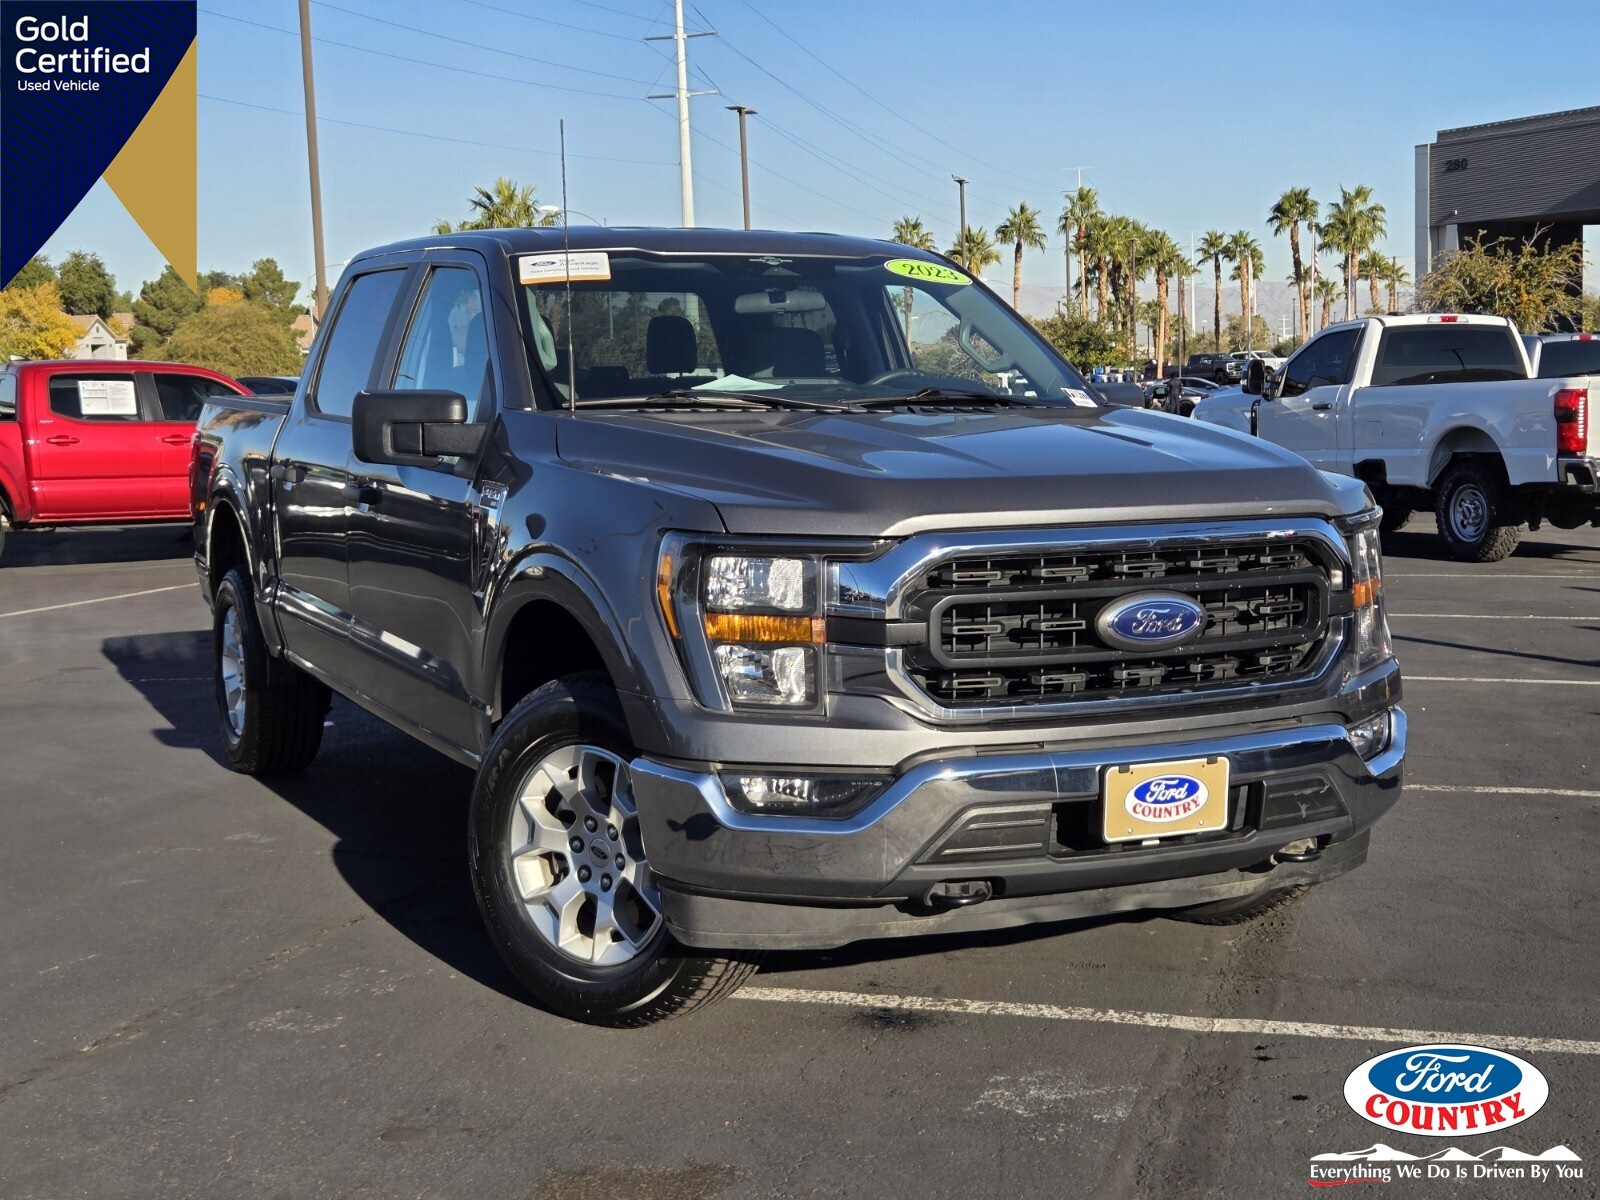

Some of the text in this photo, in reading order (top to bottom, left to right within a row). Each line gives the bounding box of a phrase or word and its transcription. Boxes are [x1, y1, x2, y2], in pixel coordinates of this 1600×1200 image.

[902, 263, 959, 280] 2023
[1132, 608, 1188, 634] Ford
[1145, 779, 1189, 803] Ford
[1132, 795, 1201, 819] COUNTRY
